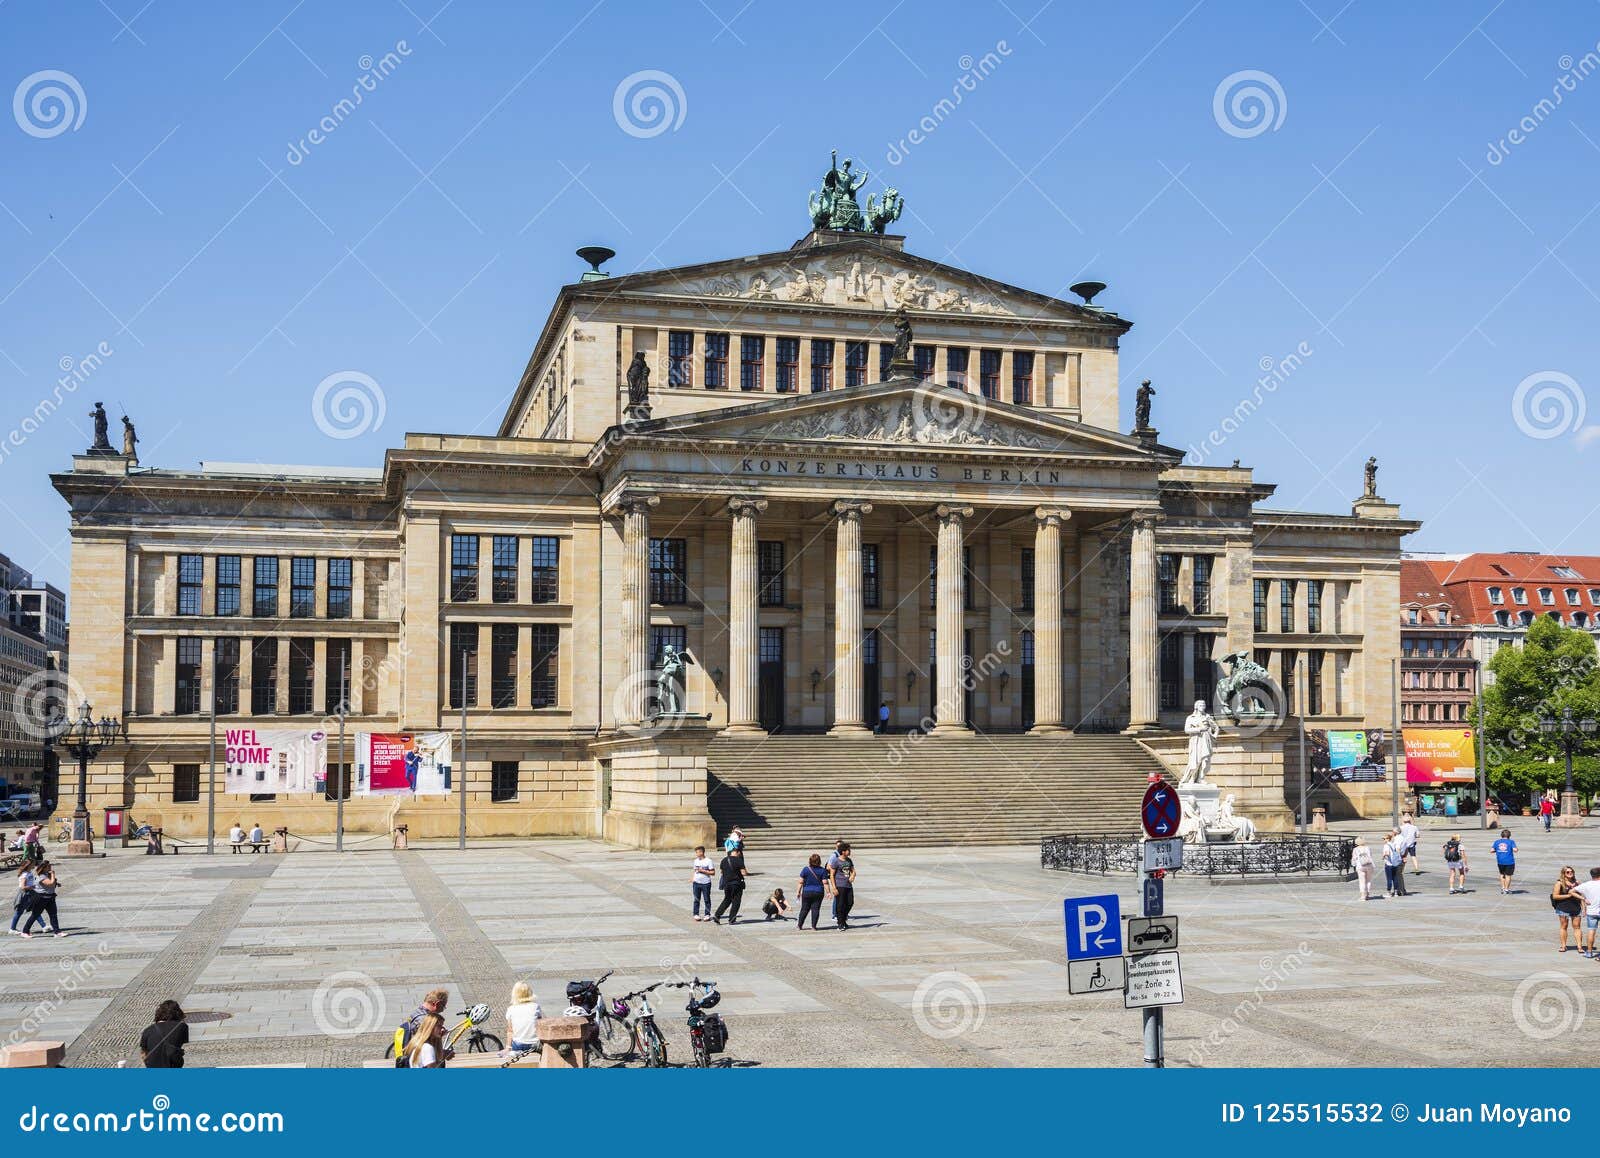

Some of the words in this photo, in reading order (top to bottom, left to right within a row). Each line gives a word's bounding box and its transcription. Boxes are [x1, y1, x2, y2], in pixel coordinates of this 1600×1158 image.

[742, 459, 939, 479] KONZERTHAUS
[964, 468, 1059, 483] BERLIN
[225, 729, 260, 746] WEL
[1406, 740, 1425, 749] Mehr
[225, 747, 272, 764] COME
[1146, 881, 1159, 912] P
[1077, 904, 1107, 952] P
[1145, 979, 1163, 989] Zone
[1166, 979, 1171, 987] 2
